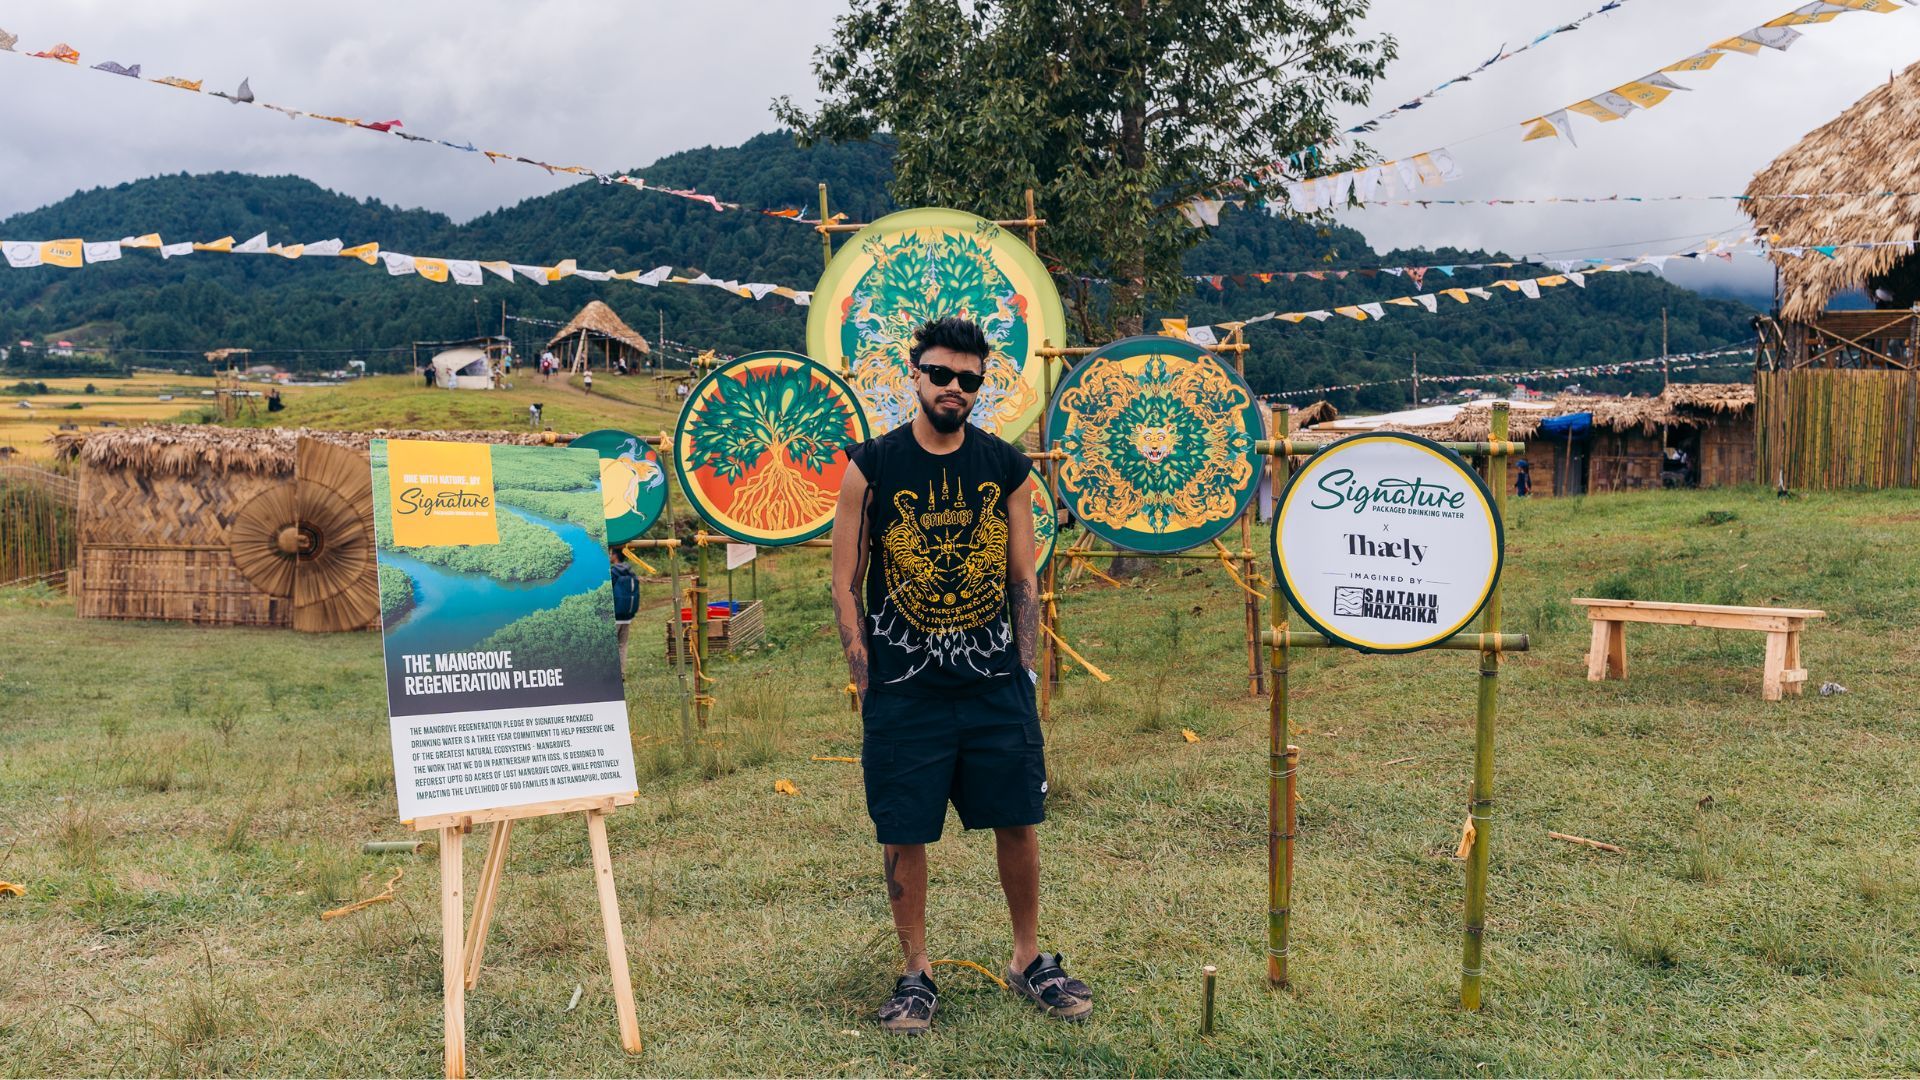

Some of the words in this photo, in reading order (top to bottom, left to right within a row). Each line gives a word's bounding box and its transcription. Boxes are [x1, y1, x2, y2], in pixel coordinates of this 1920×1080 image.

[397, 488, 490, 516] Signature
[1311, 468, 1465, 514] Signature
[1372, 506, 1406, 514] PACKAGED
[1408, 508, 1440, 517] DRINKING
[1350, 572, 1404, 582] IMAGINED
[1365, 588, 1438, 608] SANTANU
[1364, 604, 1438, 624] HAZARIKA
[402, 654, 432, 674] THE
[435, 651, 513, 672] MANGROVE
[404, 672, 511, 695] REGENERATION
[513, 668, 564, 689] PLEDGE
[410, 727, 422, 735] THE
[424, 724, 457, 735] MANGROVE
[459, 720, 502, 732] REGENERATION
[504, 719, 525, 728] PLEDGE
[535, 716, 565, 725] SIGNATURE
[566, 714, 593, 723] PACKAGED
[412, 739, 441, 748] DRINKING
[442, 736, 463, 746] WATER
[477, 734, 496, 743] THREE
[497, 732, 512, 741] YEAR
[513, 729, 551, 739] COMMITMENT
[560, 727, 575, 735] HELP
[576, 725, 603, 734] PRESERVE
[412, 753, 420, 761] OF
[422, 752, 434, 760] THE
[436, 749, 465, 759] GREATEST
[466, 746, 493, 756] NATURAL
[494, 743, 531, 753] ECOSYSTEMS
[414, 766, 426, 774] THE
[427, 764, 446, 773] WORK
[447, 762, 462, 771] THAT
[463, 761, 473, 769] WE
[492, 756, 530, 766] PARTNERSHIP
[532, 754, 546, 762] WITH
[570, 750, 596, 759] DESIGNED
[415, 777, 446, 787] REFOREST
[448, 775, 463, 784] UPTO
[464, 774, 473, 782] 60
[474, 772, 493, 780] ACRES
[503, 769, 517, 778] LOST
[518, 766, 550, 776] MANGROVE
[572, 762, 589, 771] WHILE
[590, 759, 620, 769] POSITIVELY
[416, 789, 451, 800] IMPACTING
[452, 788, 464, 796] THE
[464, 784, 499, 795] LIVELIHOOD
[501, 783, 508, 791] OF
[510, 782, 522, 790] 600
[523, 780, 548, 789] FAMILIES
